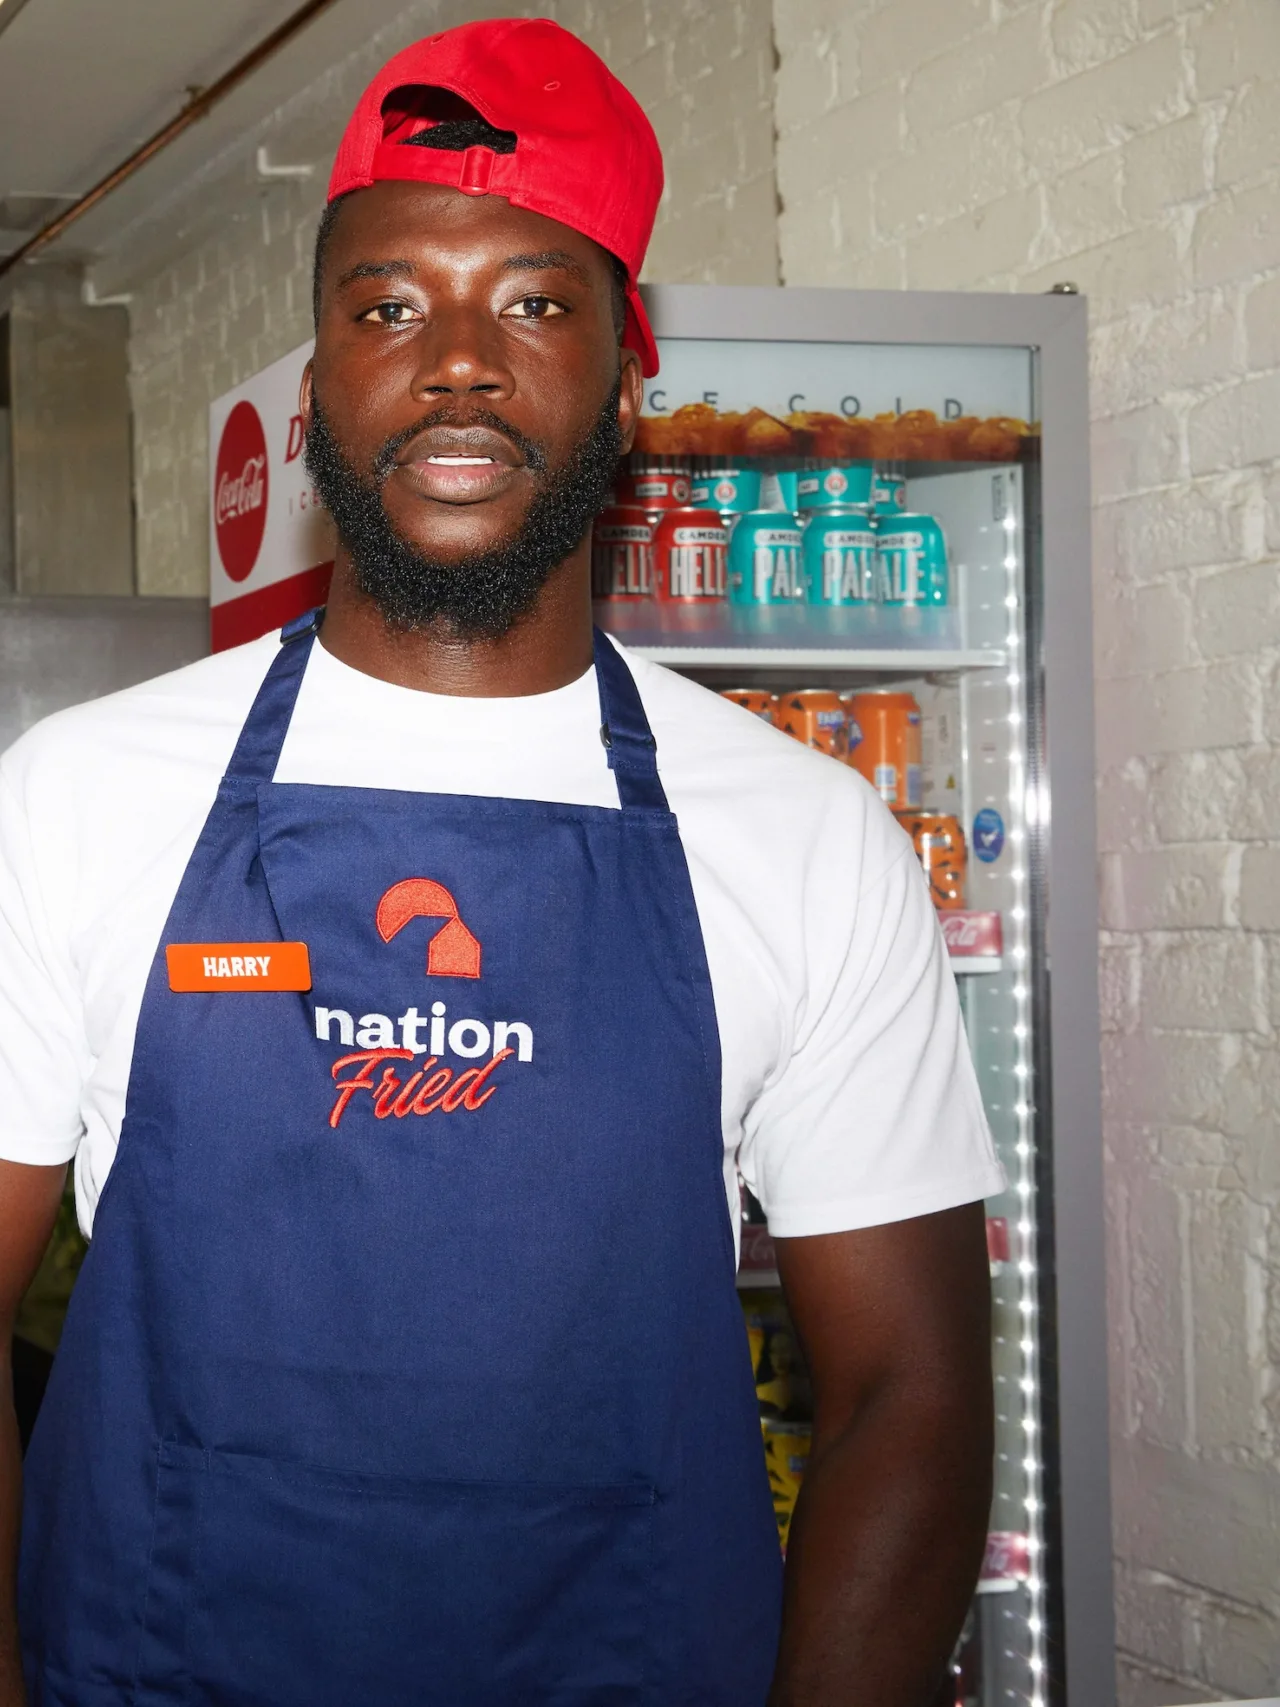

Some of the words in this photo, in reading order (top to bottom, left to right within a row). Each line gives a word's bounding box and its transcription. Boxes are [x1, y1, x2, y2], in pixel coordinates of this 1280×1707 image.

[670, 546, 727, 597] HELL
[202, 956, 271, 978] HARRY
[314, 1000, 534, 1063] nation
[328, 1047, 516, 1129] Fried
